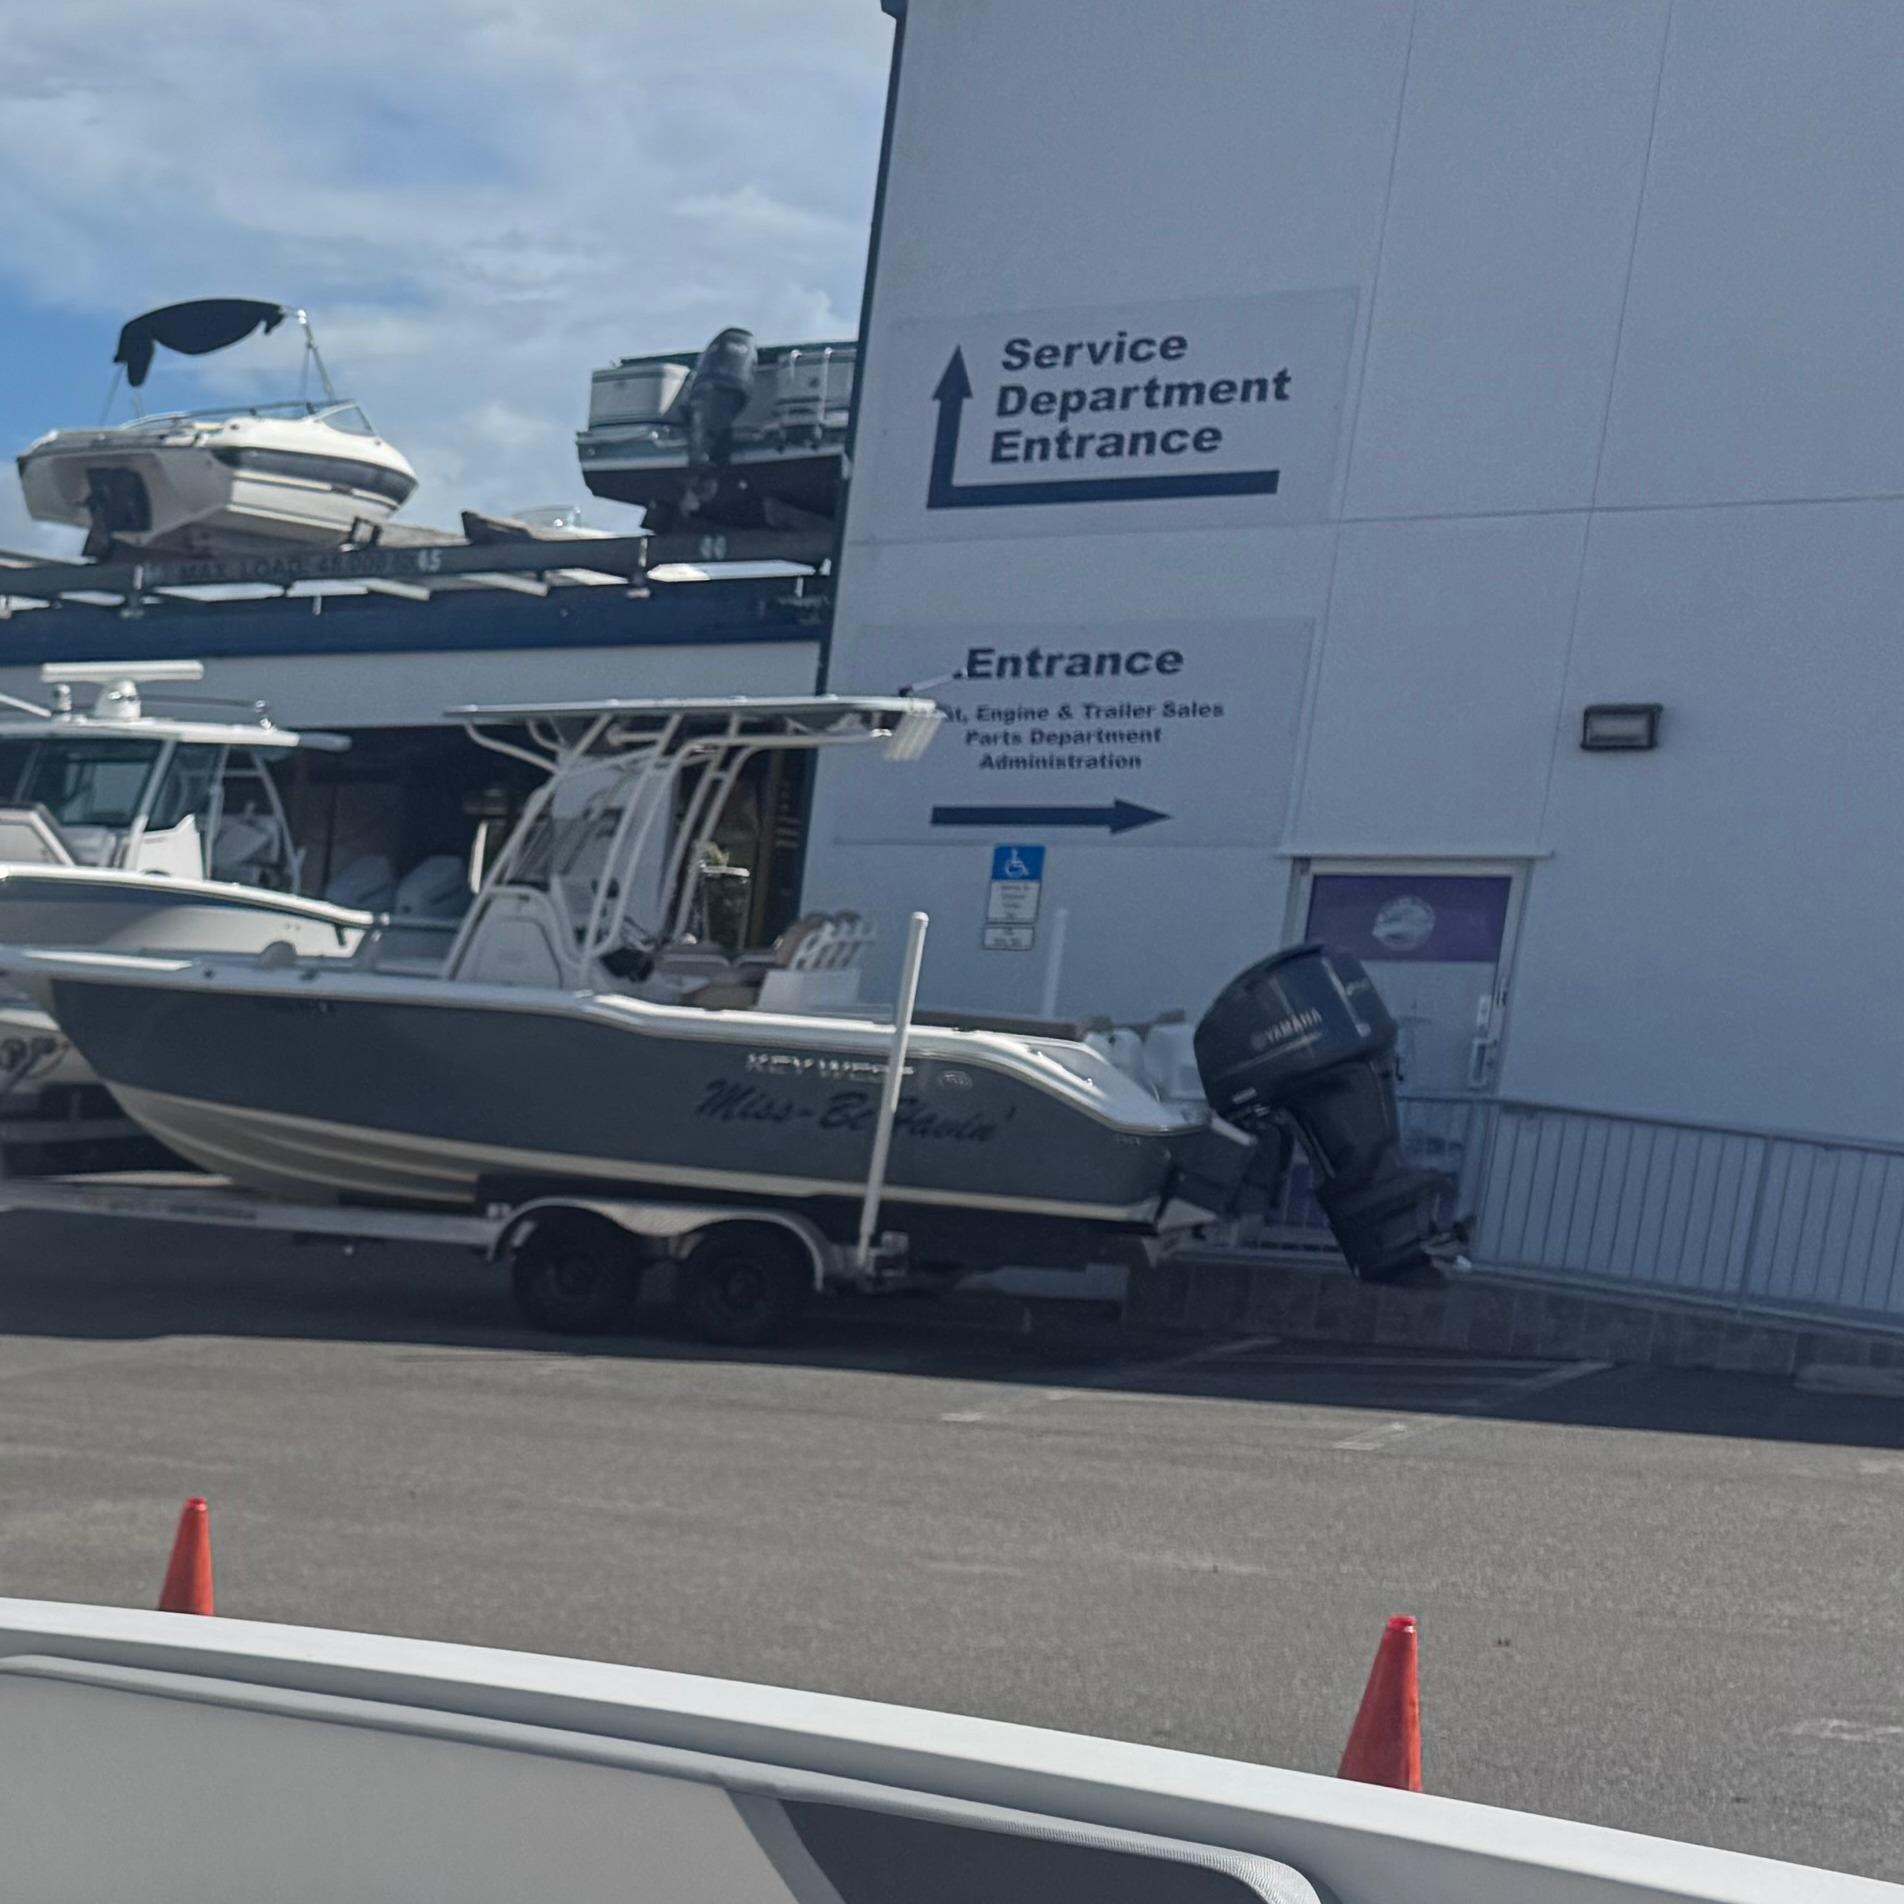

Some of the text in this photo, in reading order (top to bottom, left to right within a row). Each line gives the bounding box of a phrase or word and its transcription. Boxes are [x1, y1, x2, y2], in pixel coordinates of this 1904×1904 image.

[1001, 331, 1188, 371] Service
[996, 368, 1292, 422] Department
[990, 424, 1223, 464] Entrance
[965, 647, 1185, 681] Entrance
[976, 703, 1050, 726] Engine
[1057, 703, 1074, 721] &
[1083, 701, 1156, 720] Trailer
[1162, 700, 1225, 719] Sales
[965, 727, 1163, 748] Parts Department
[978, 753, 1143, 771] Administration
[1265, 1007, 1323, 1045] YAMAHA
